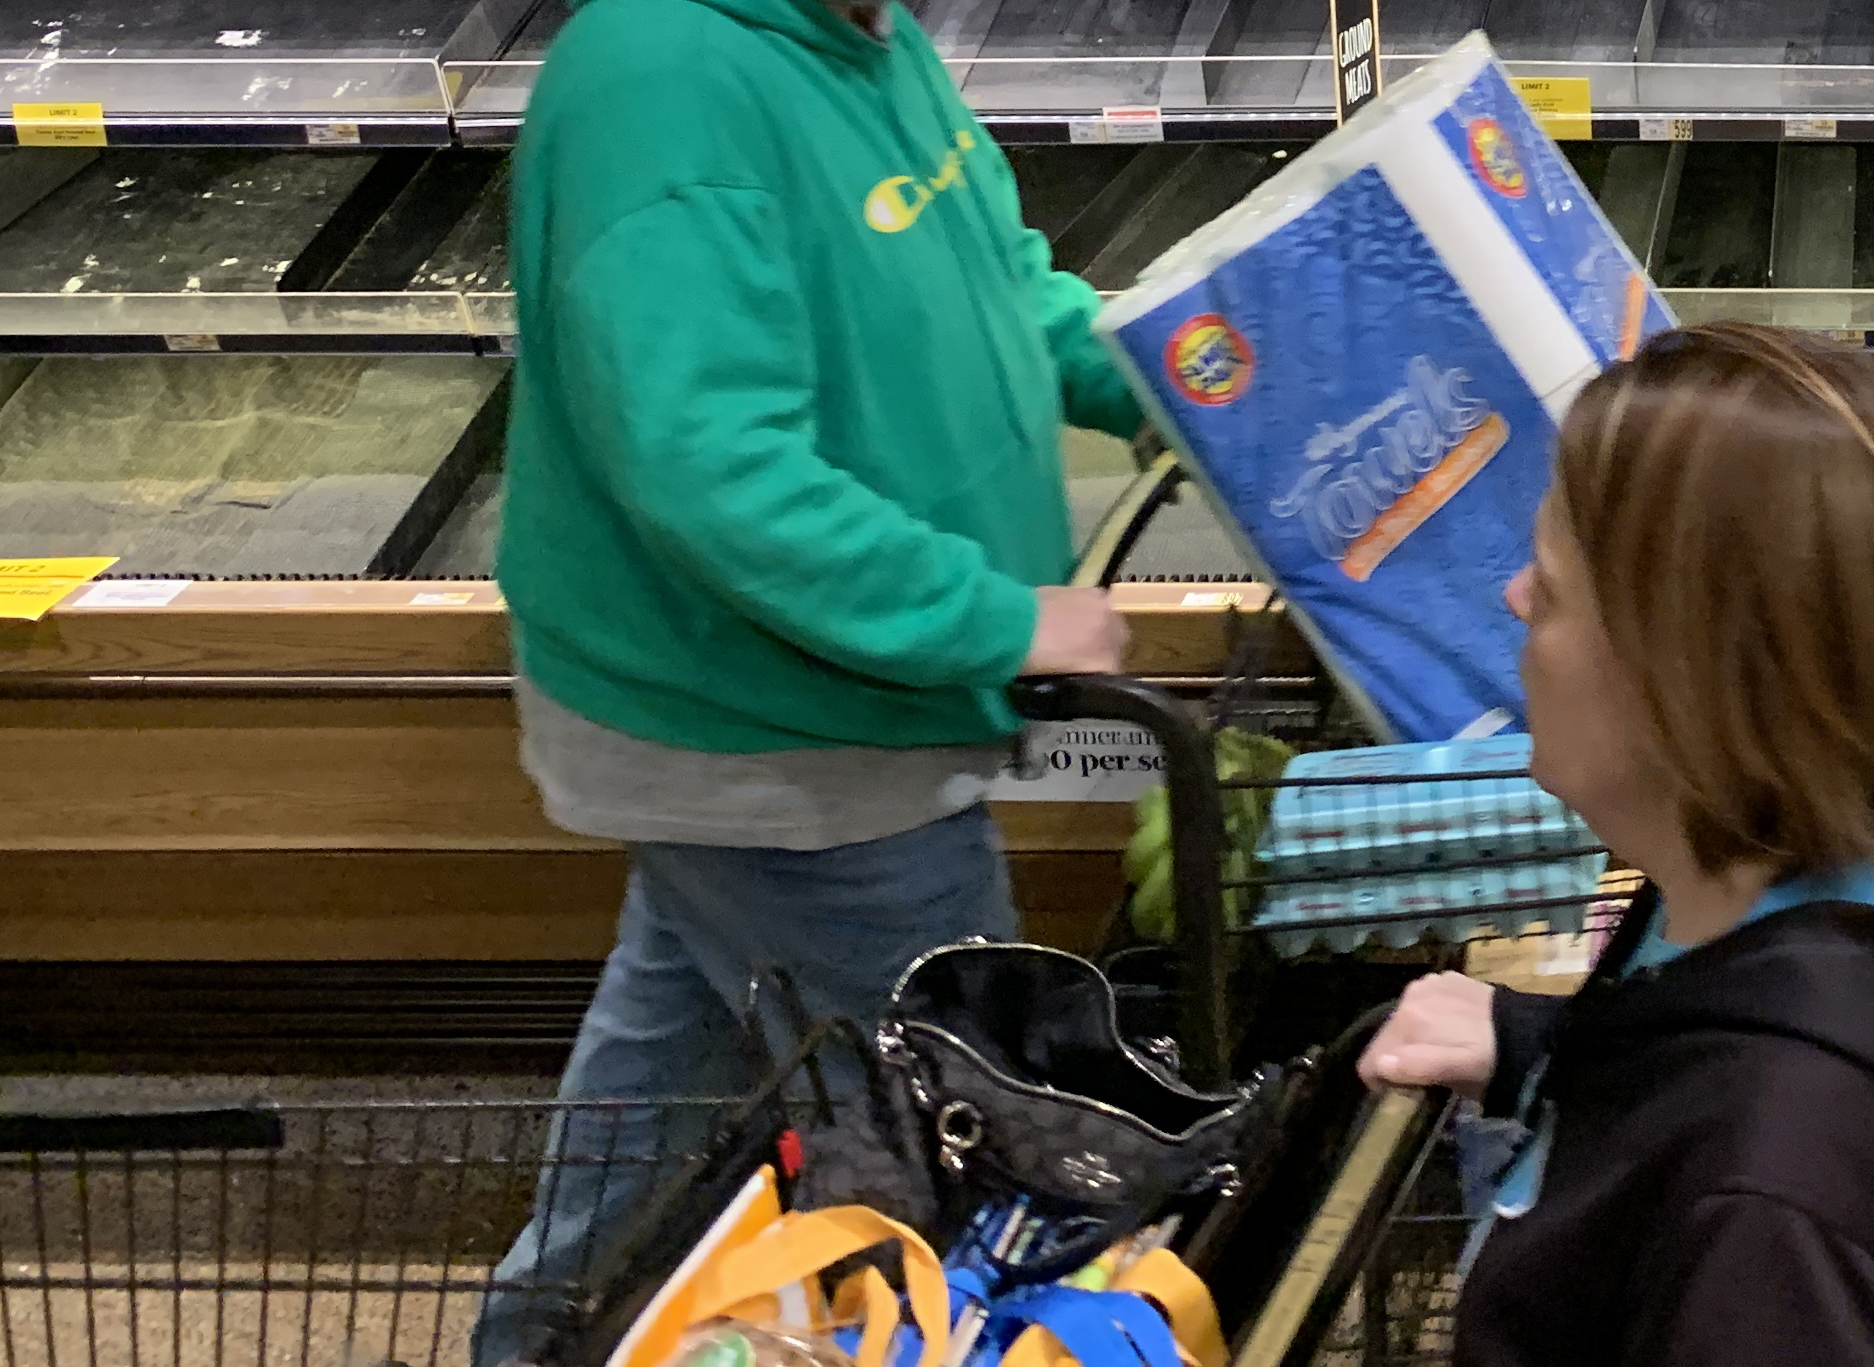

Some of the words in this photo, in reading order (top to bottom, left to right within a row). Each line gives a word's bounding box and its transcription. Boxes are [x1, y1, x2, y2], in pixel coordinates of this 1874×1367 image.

[1338, 17, 1373, 68] GROUND
[1344, 58, 1372, 106] MEATS
[1080, 751, 1131, 778] per
